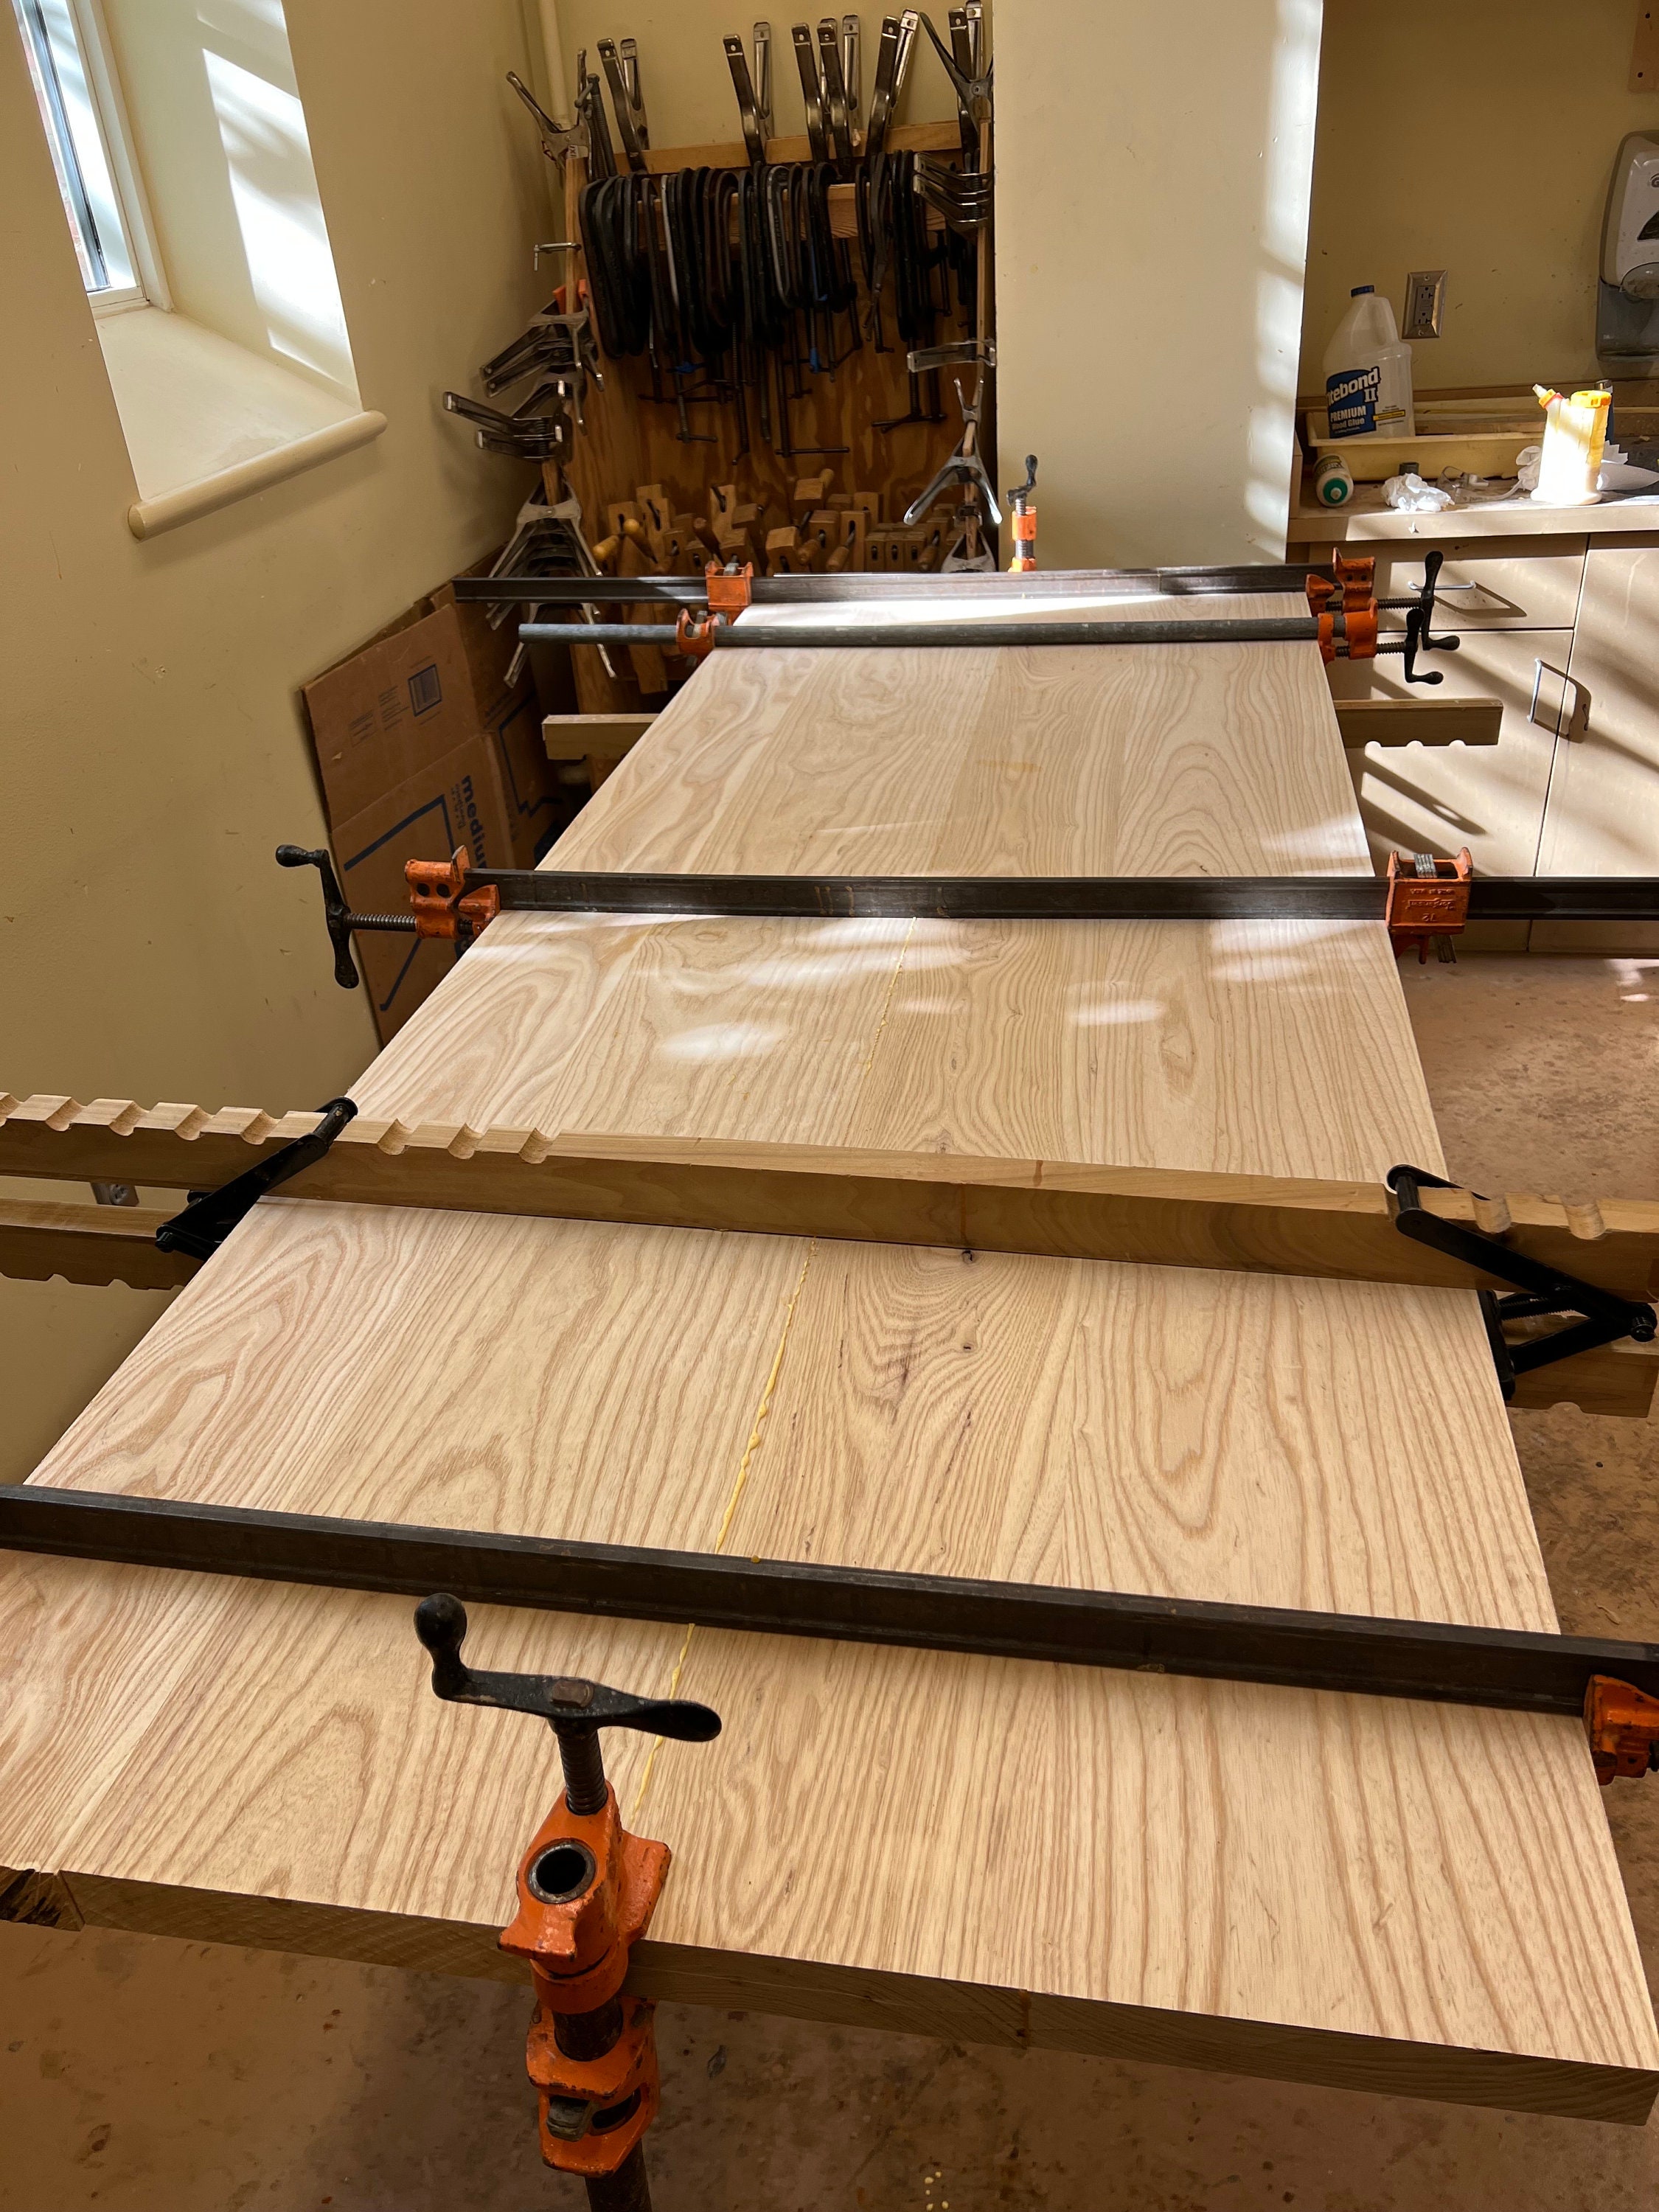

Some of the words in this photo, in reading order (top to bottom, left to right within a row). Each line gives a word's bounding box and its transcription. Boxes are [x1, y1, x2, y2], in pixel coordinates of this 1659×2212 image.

[1328, 368, 1379, 406] itebond
[1364, 387, 1377, 403] II
[1330, 405, 1367, 422] PREMIUM
[462, 775, 487, 868] mediu
